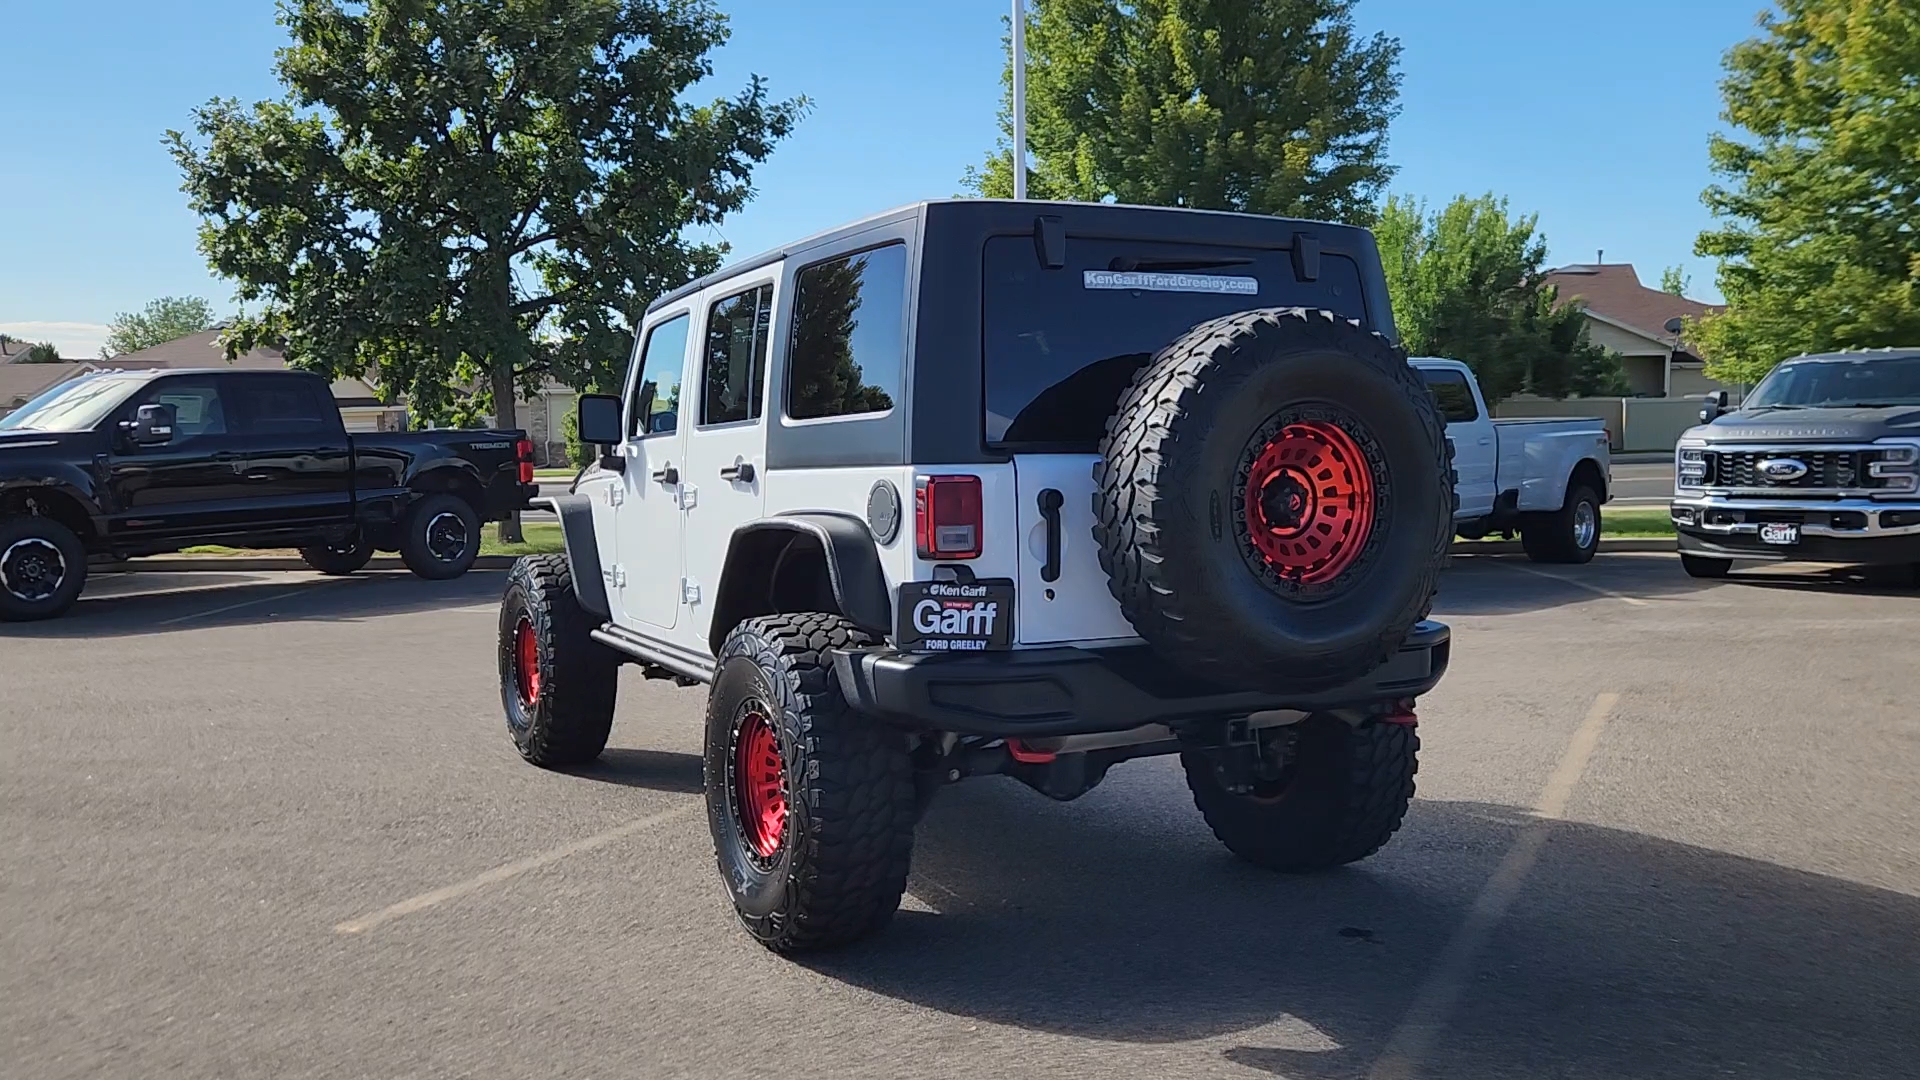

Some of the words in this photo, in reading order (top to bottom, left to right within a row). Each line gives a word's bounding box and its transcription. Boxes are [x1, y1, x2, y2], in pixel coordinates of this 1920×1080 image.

[1085, 271, 1257, 291] KenGarffFordGreeley.com
[469, 441, 511, 450] TREMOR
[1760, 526, 1797, 541] Garff
[939, 584, 960, 597] Ken
[960, 585, 987, 597] Garff
[913, 599, 997, 635] Garff
[926, 639, 949, 650] FORD
[949, 639, 987, 650] GREELEY
